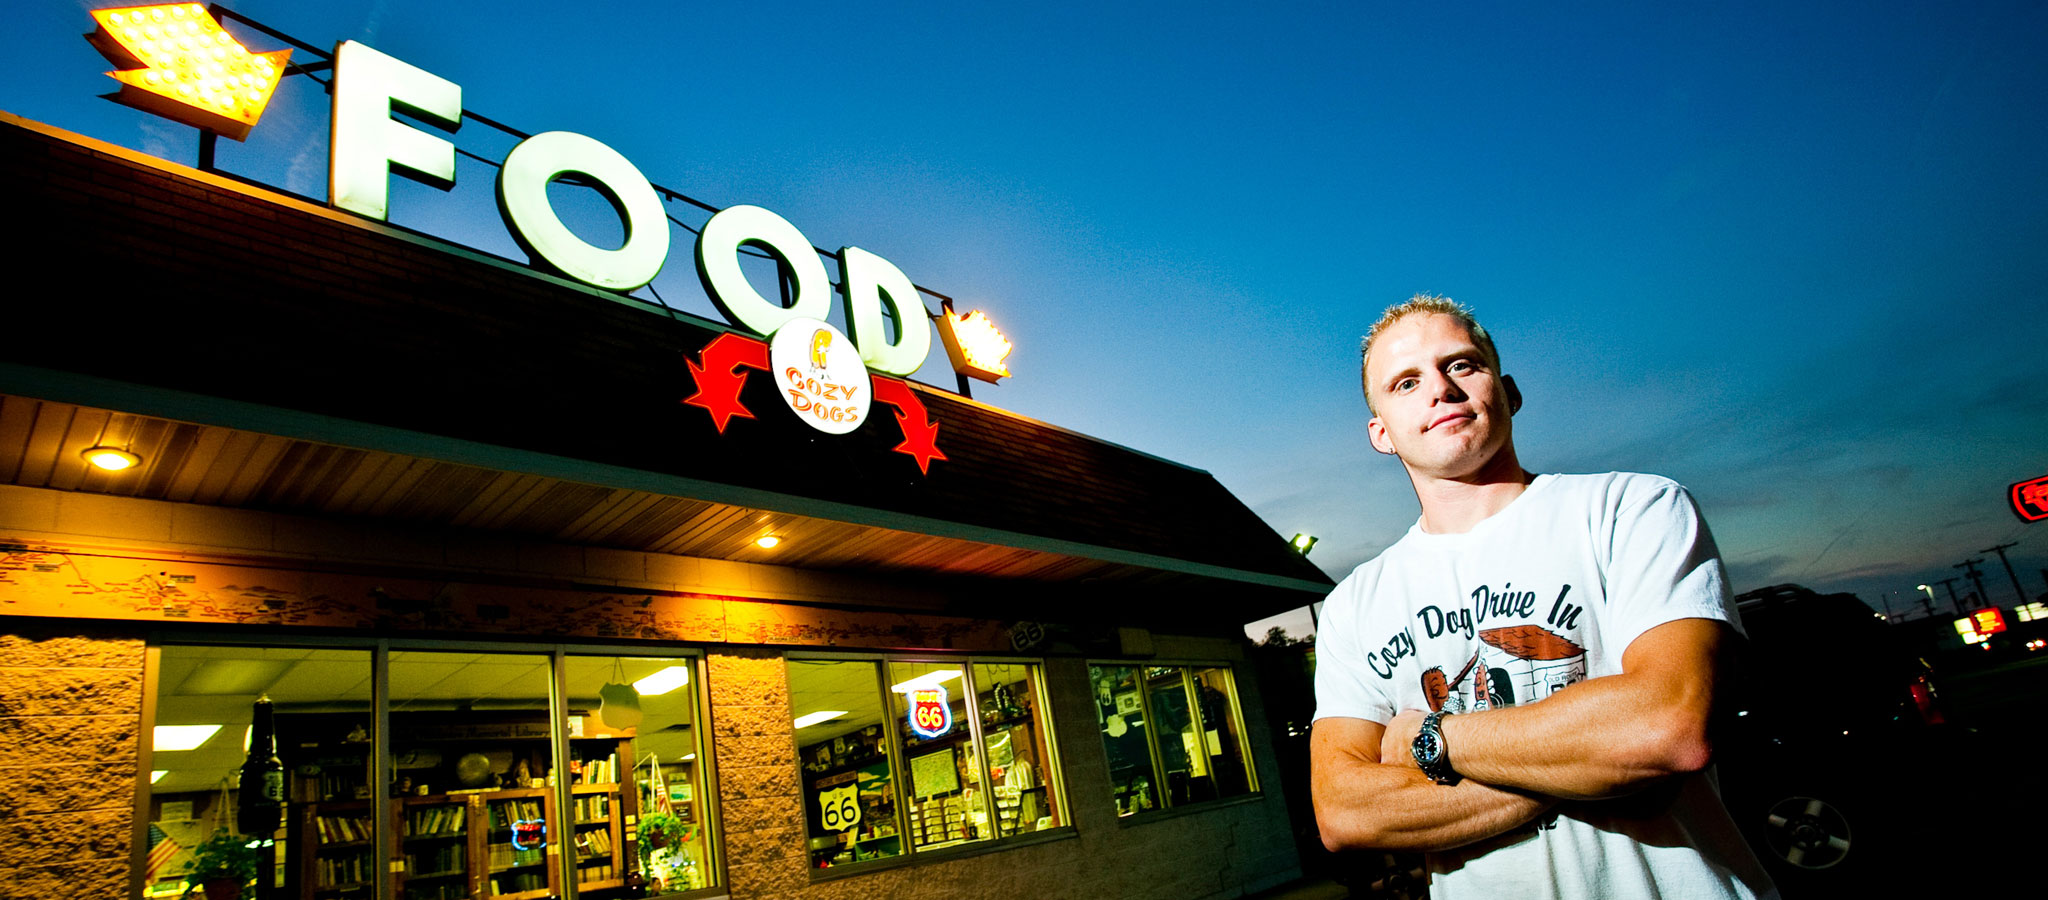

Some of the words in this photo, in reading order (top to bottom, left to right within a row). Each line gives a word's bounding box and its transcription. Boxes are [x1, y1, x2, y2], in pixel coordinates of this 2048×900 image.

[330, 40, 931, 376] FOOD
[785, 366, 858, 401] COZY
[787, 388, 858, 423] DOGS
[1367, 626, 1416, 679] Cozy
[1416, 605, 1475, 640] Dog
[1471, 582, 1536, 624] Drive
[1547, 584, 1583, 630] In
[917, 706, 943, 727] 66
[825, 797, 856, 826] 66
